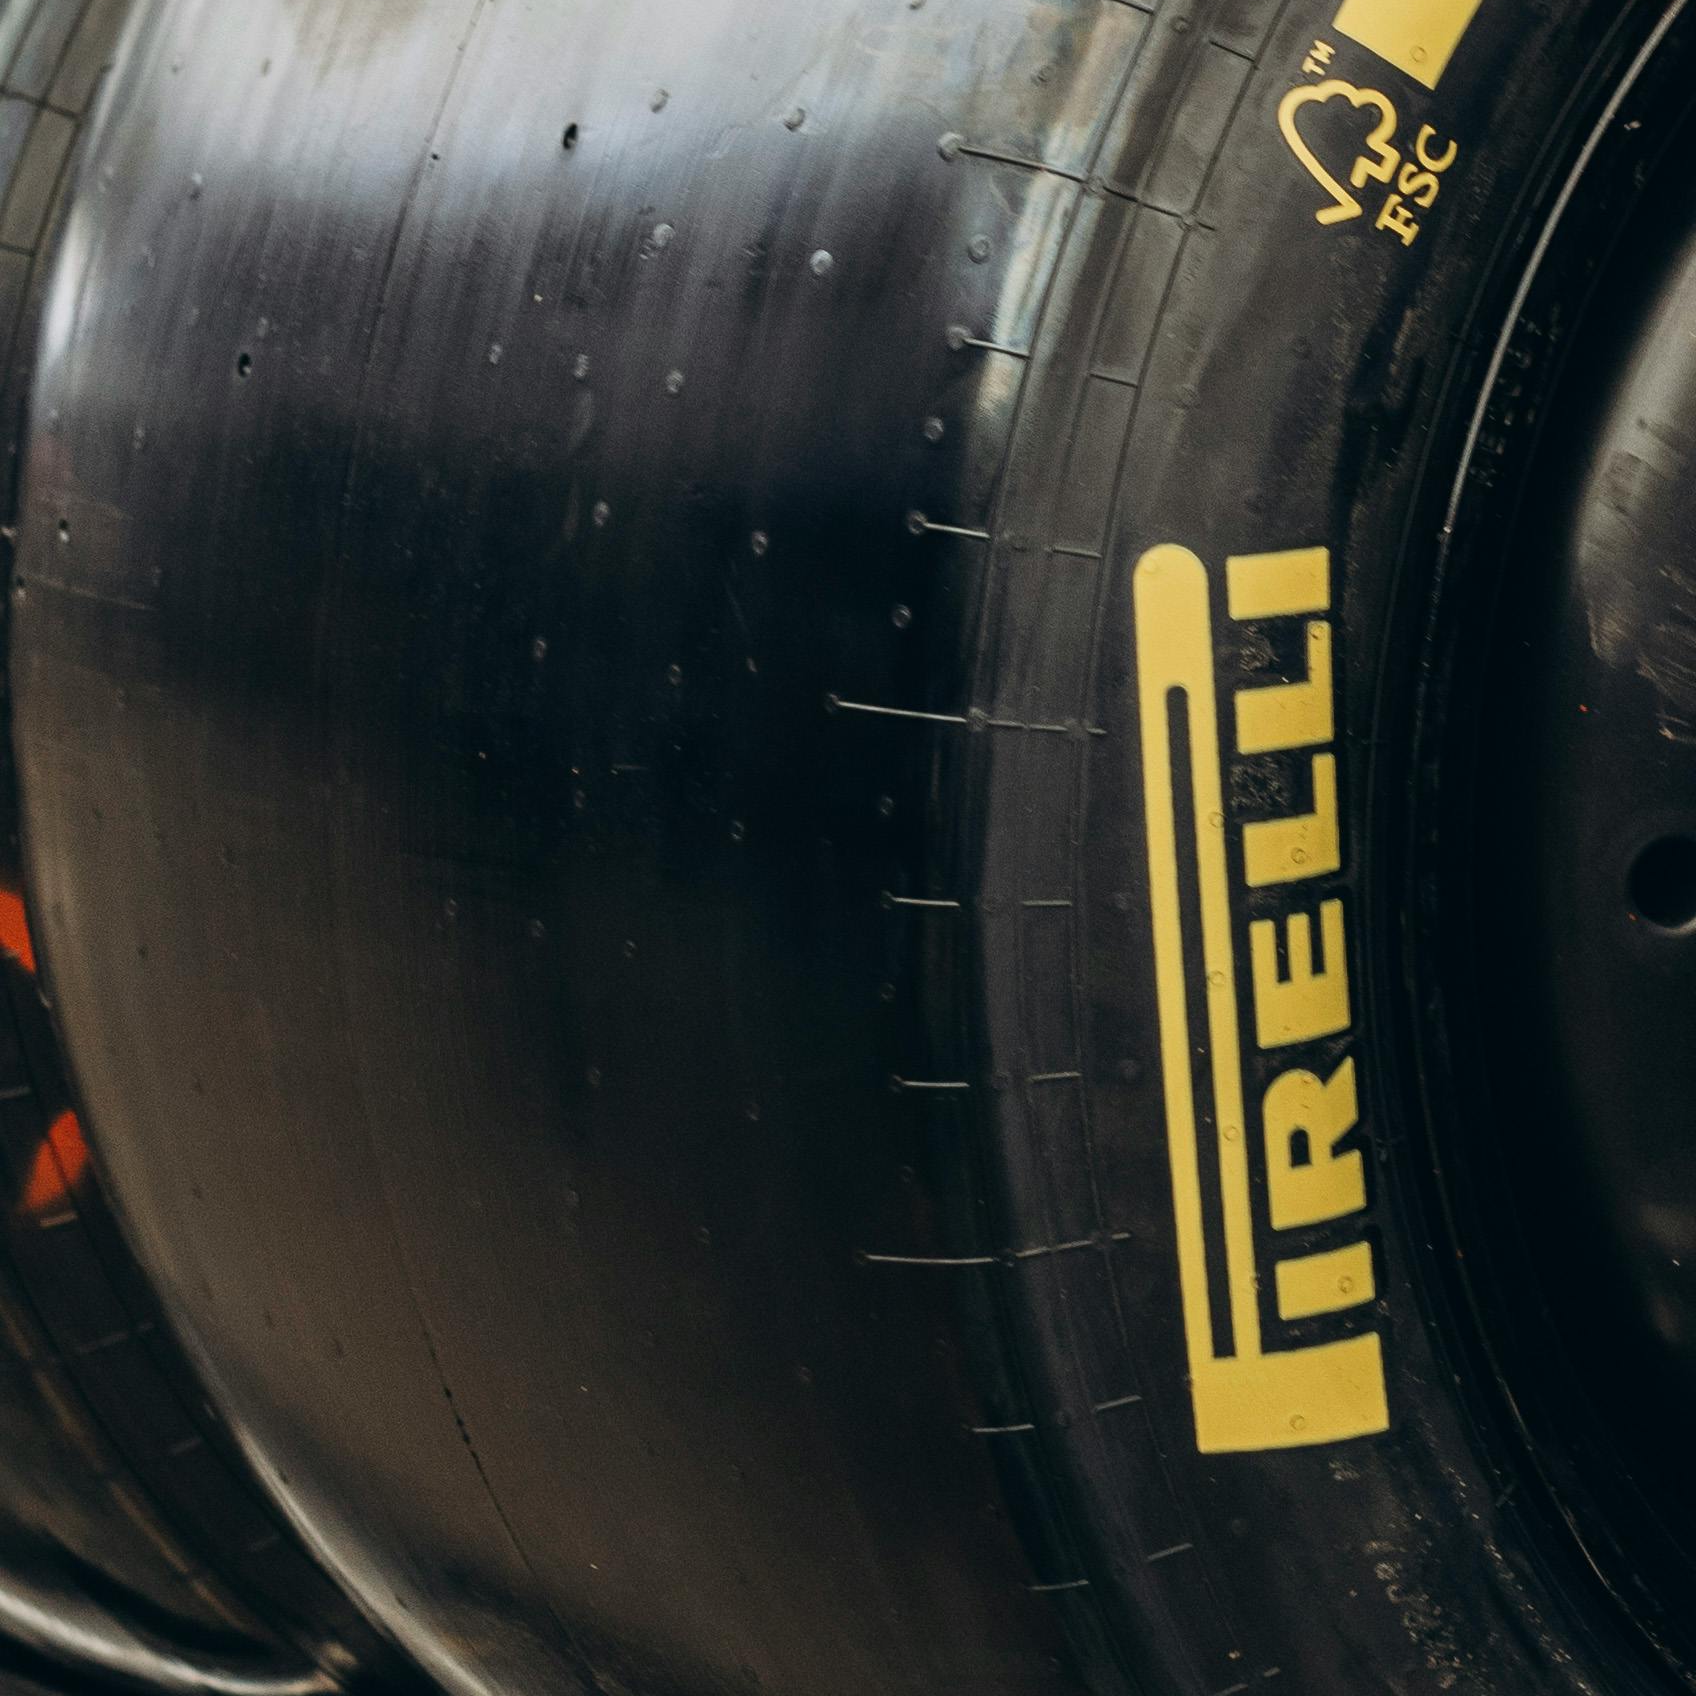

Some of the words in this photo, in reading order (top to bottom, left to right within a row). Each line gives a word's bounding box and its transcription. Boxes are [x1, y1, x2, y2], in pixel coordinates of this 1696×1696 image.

[1301, 39, 1337, 76] TM
[1375, 123, 1458, 247] FSC
[1133, 542, 1391, 1455] PIRELLI
